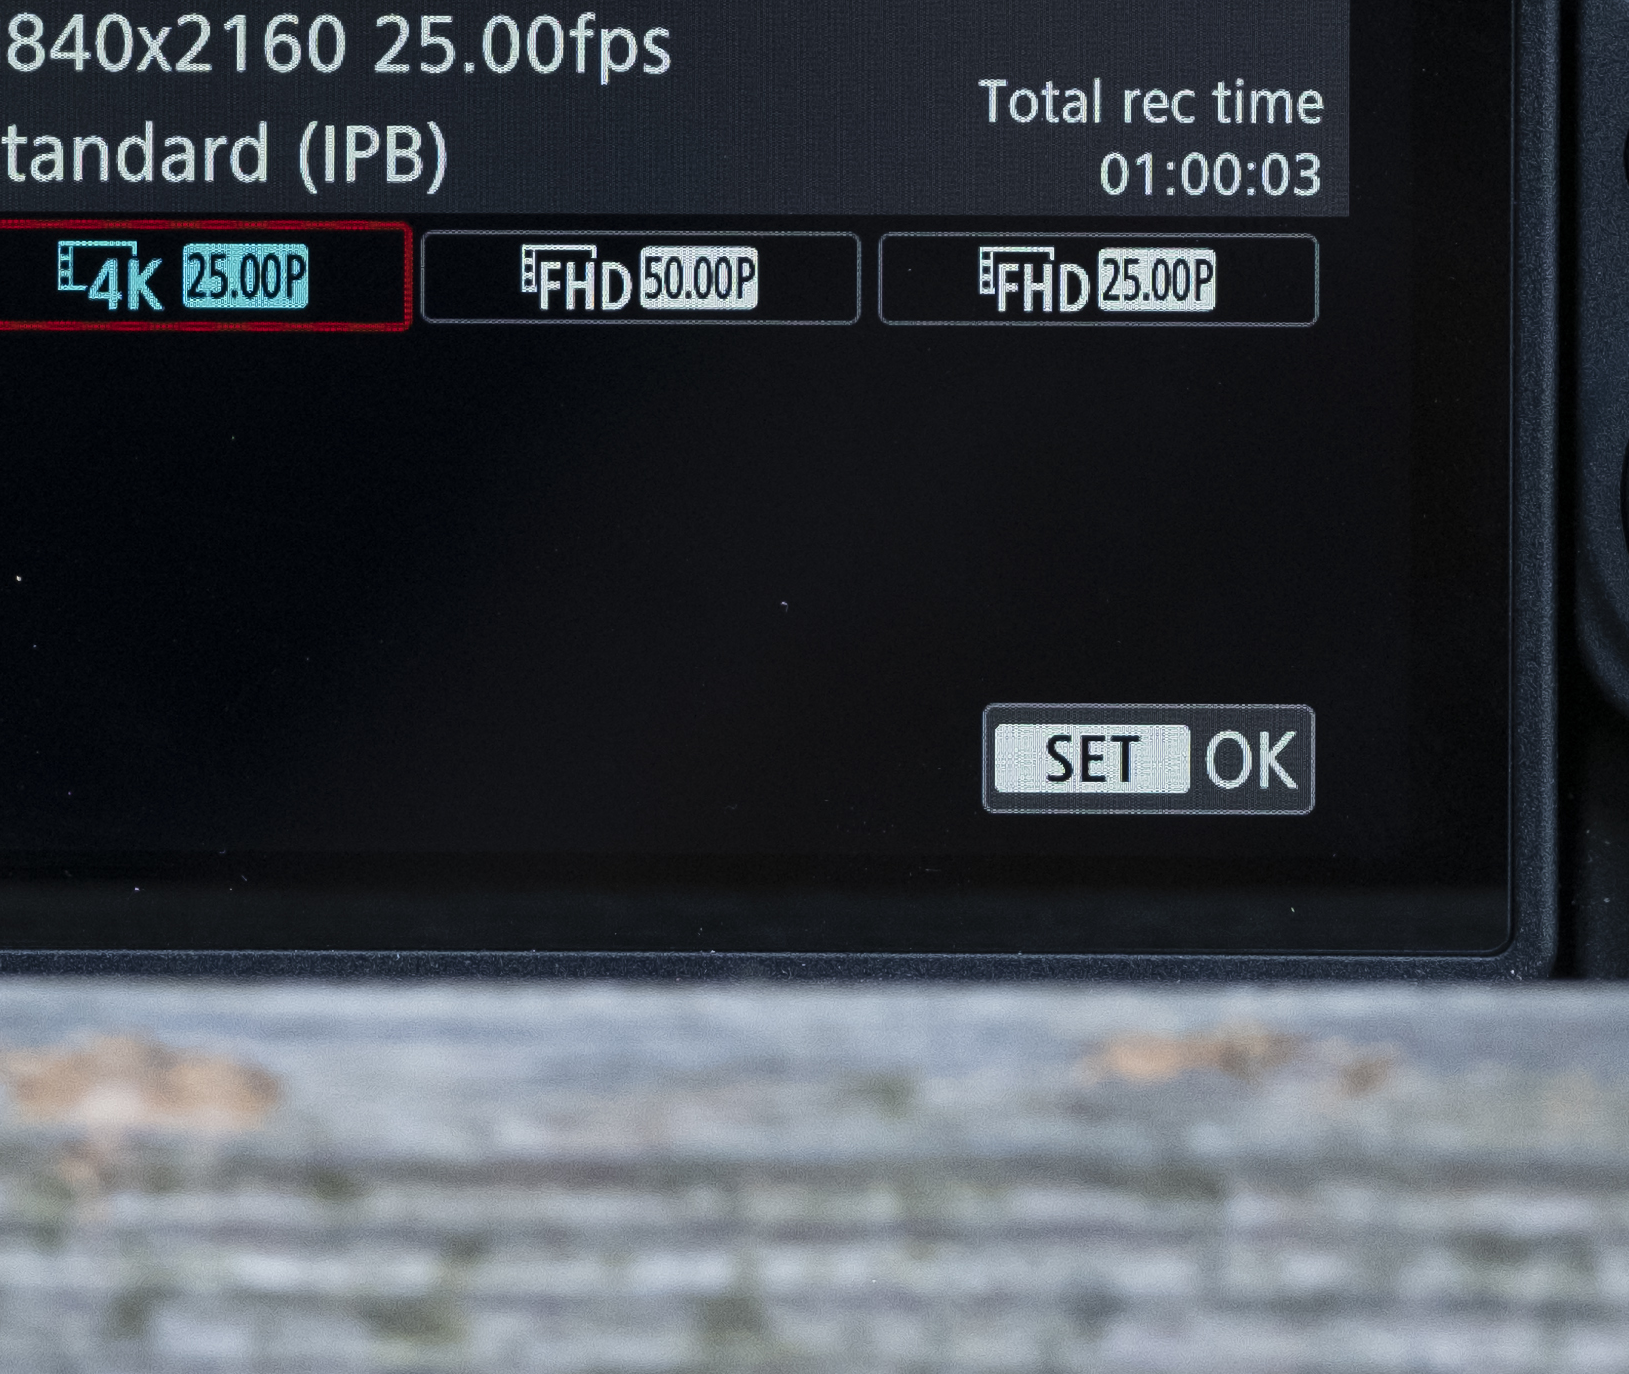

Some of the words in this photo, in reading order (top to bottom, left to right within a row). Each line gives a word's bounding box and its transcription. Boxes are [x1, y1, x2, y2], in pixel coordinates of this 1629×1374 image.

[374, 11, 672, 86] 25.00fps
[977, 77, 1102, 124] Total
[1124, 88, 1197, 124] rec
[1212, 77, 1325, 124] time
[299, 120, 448, 195] (IPB)
[1100, 151, 1321, 197] 01:00:03
[87, 257, 165, 311] 4K
[186, 251, 307, 302] 25.00P
[540, 261, 633, 311] FHD
[642, 253, 756, 302] 50.00P
[997, 263, 1091, 313] FHD
[1100, 255, 1214, 304] 25.00P
[1045, 733, 1141, 783] SET
[1204, 729, 1299, 790] OK
